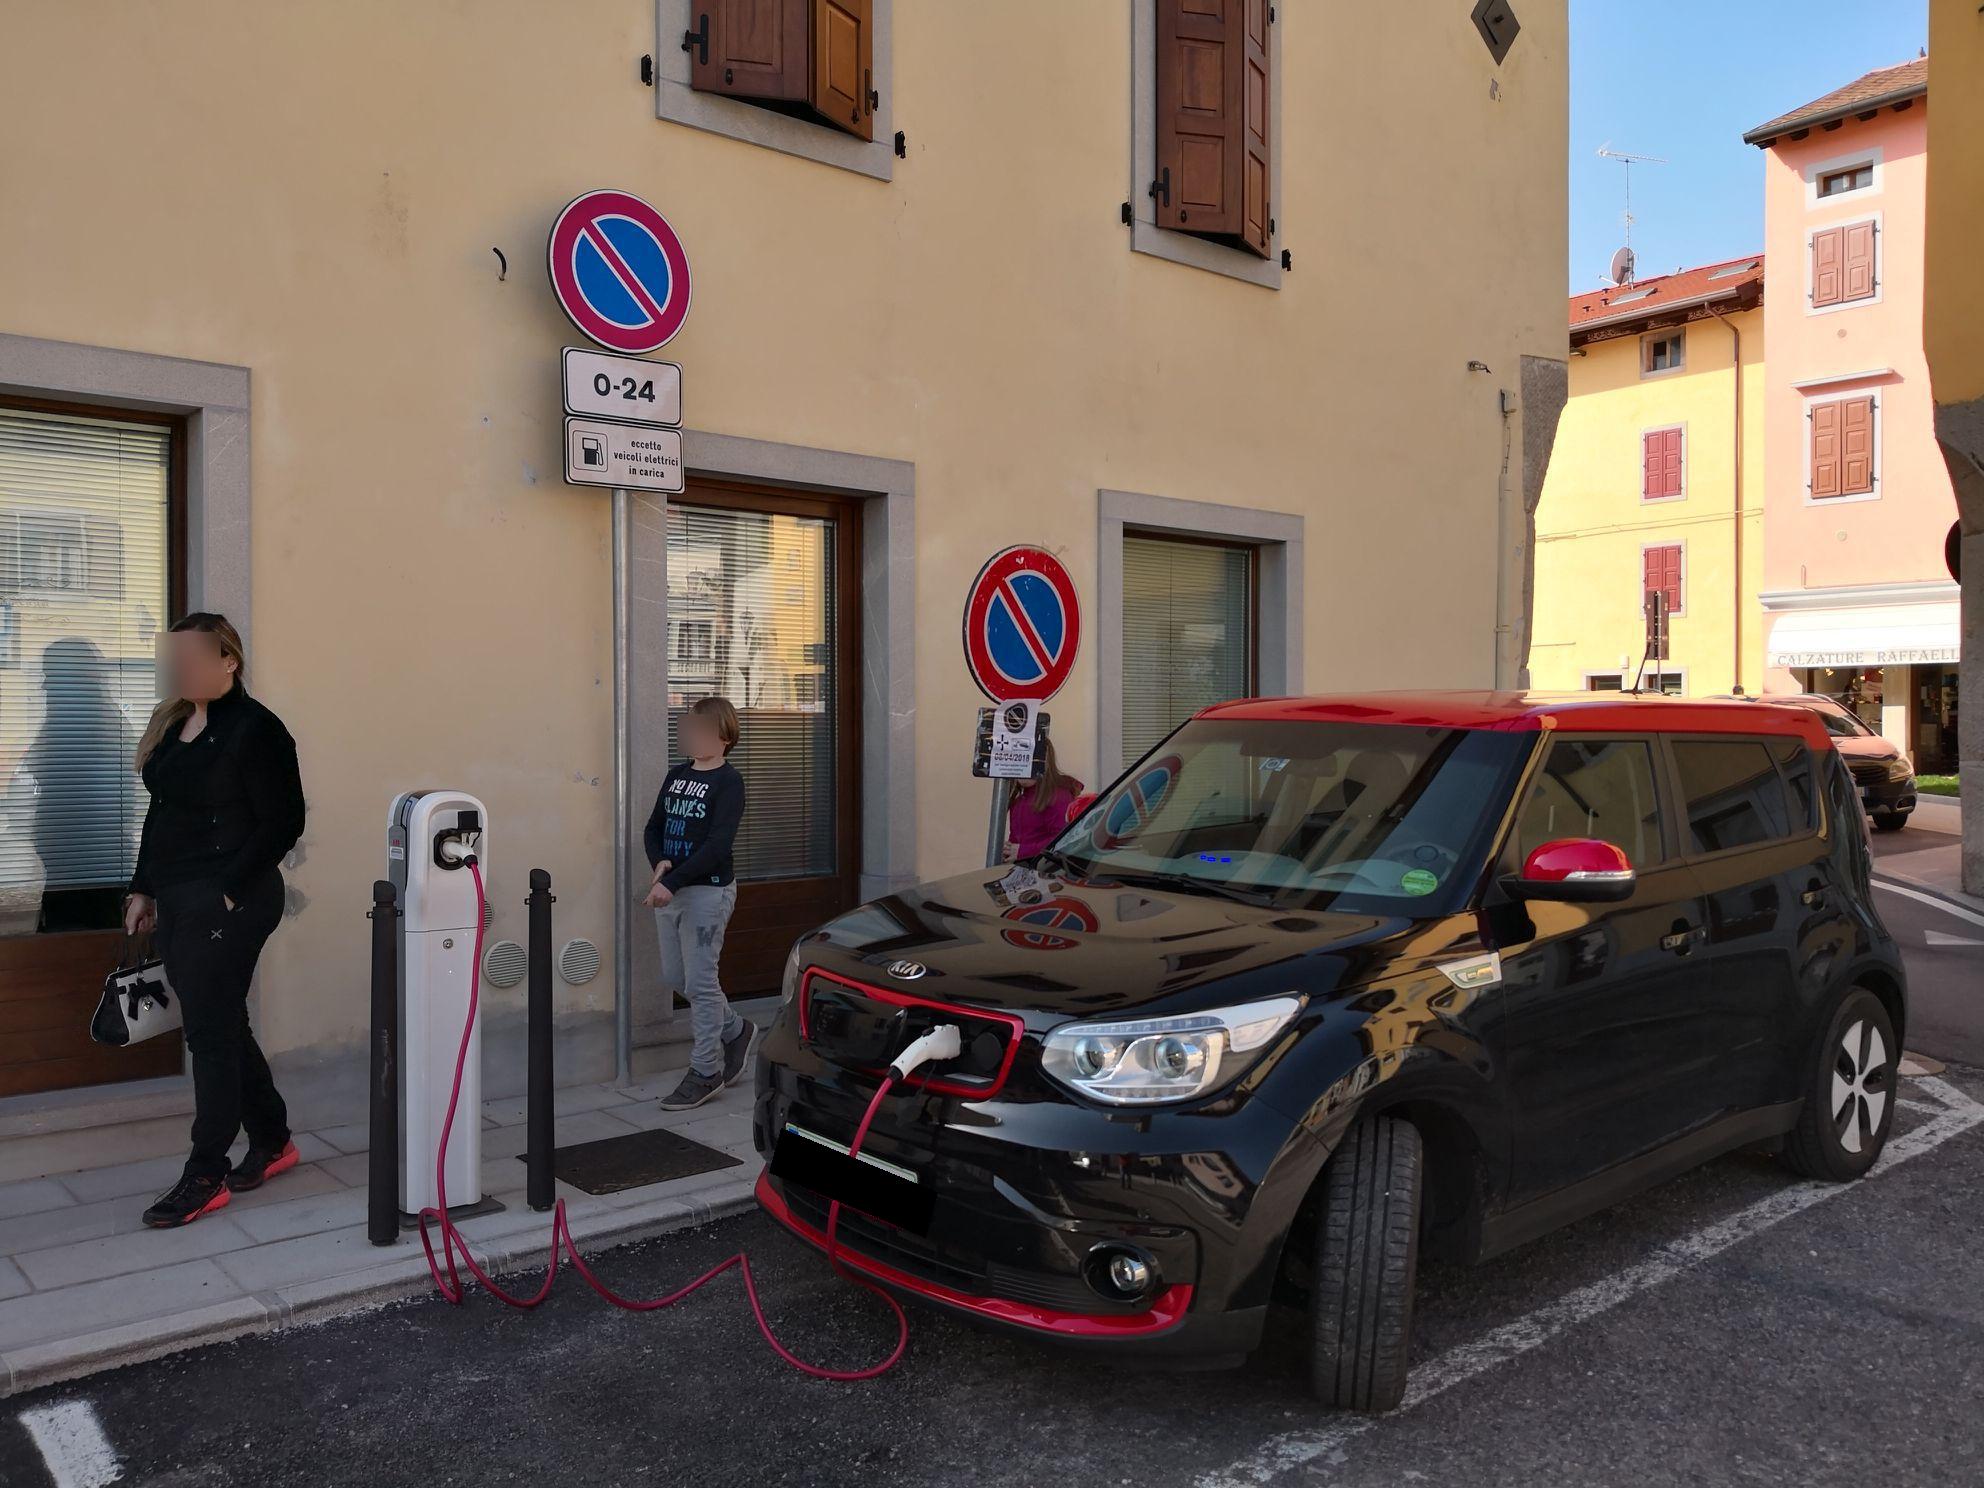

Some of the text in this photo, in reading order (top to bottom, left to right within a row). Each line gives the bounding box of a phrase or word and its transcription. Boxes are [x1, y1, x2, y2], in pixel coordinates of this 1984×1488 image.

[594, 373, 655, 403] 0-24
[631, 440, 662, 451] eccetto
[614, 451, 679, 467] veicoli elettrici
[629, 465, 664, 478] in carica
[1777, 652, 1864, 666] CALZATURE
[668, 779, 709, 798] NO BIG
[890, 960, 920, 976] KIA
